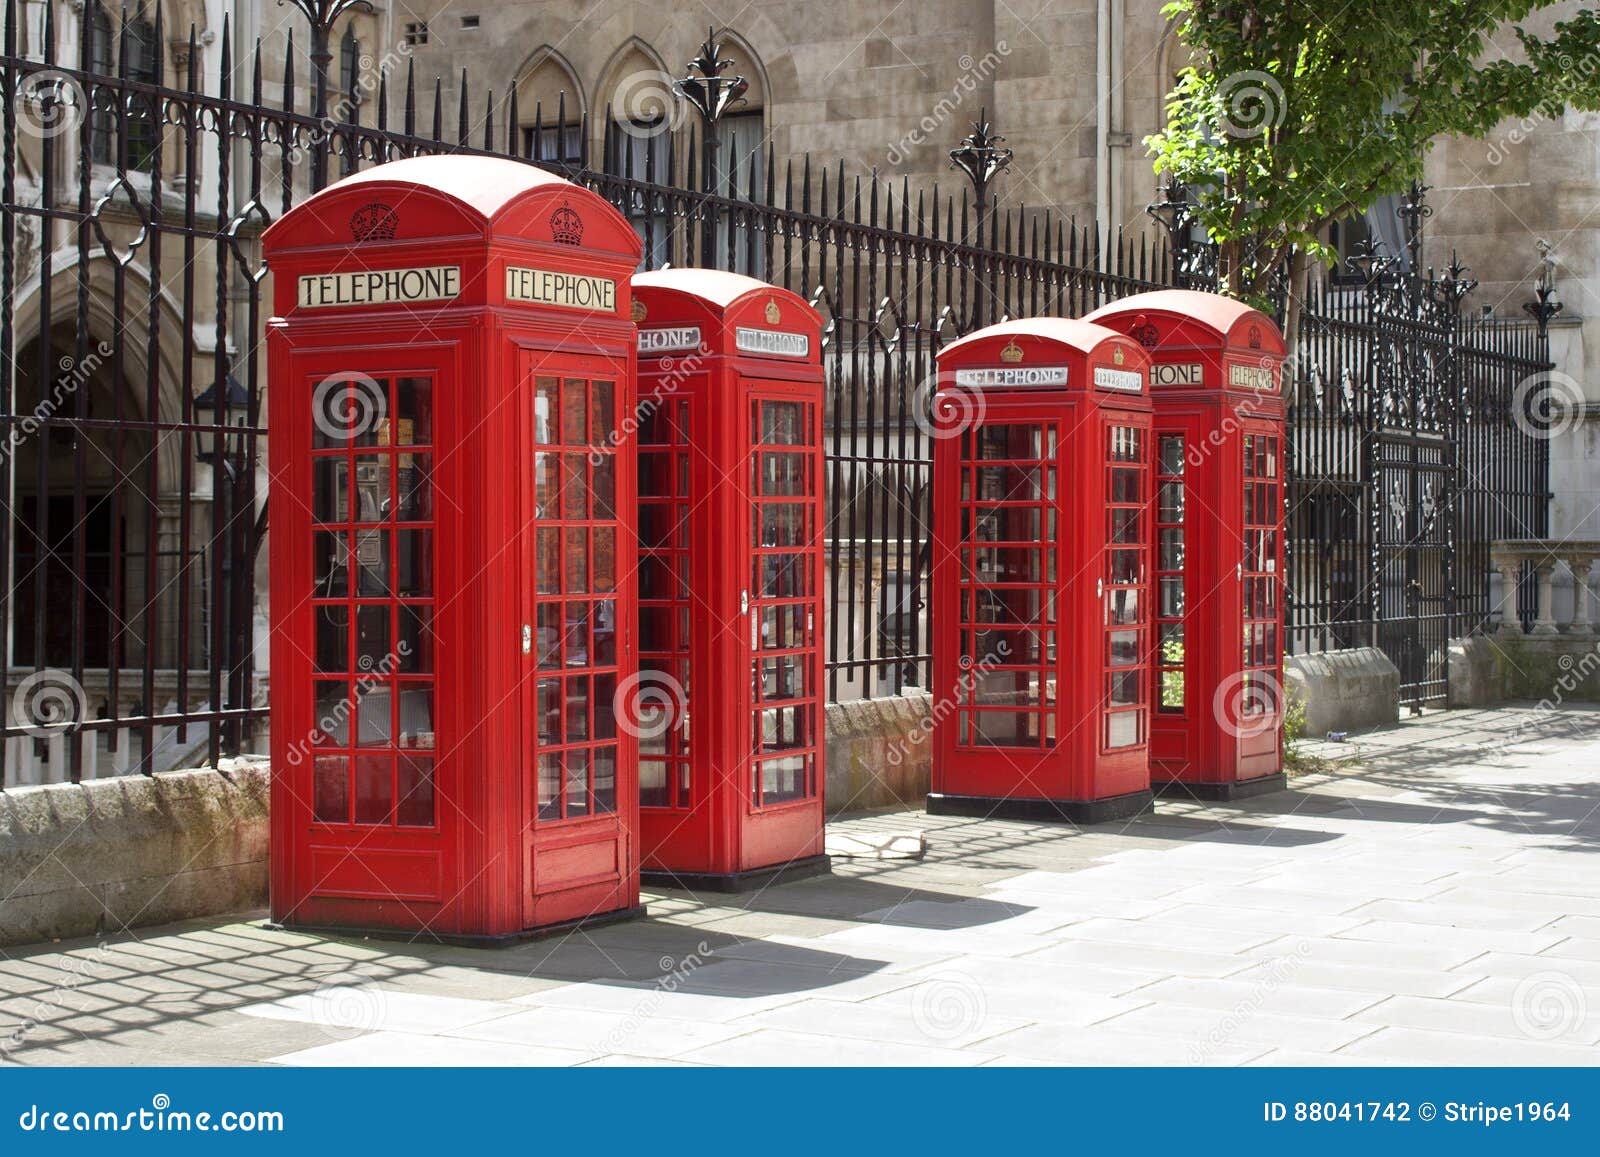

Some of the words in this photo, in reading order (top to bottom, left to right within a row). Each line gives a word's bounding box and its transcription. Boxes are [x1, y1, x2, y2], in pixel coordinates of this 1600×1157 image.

[302, 267, 459, 305] TELEPHONE
[507, 267, 613, 308] TELEPHONE
[961, 368, 1065, 385] TELEPHONE
[1230, 366, 1274, 389] TELEPHONE
